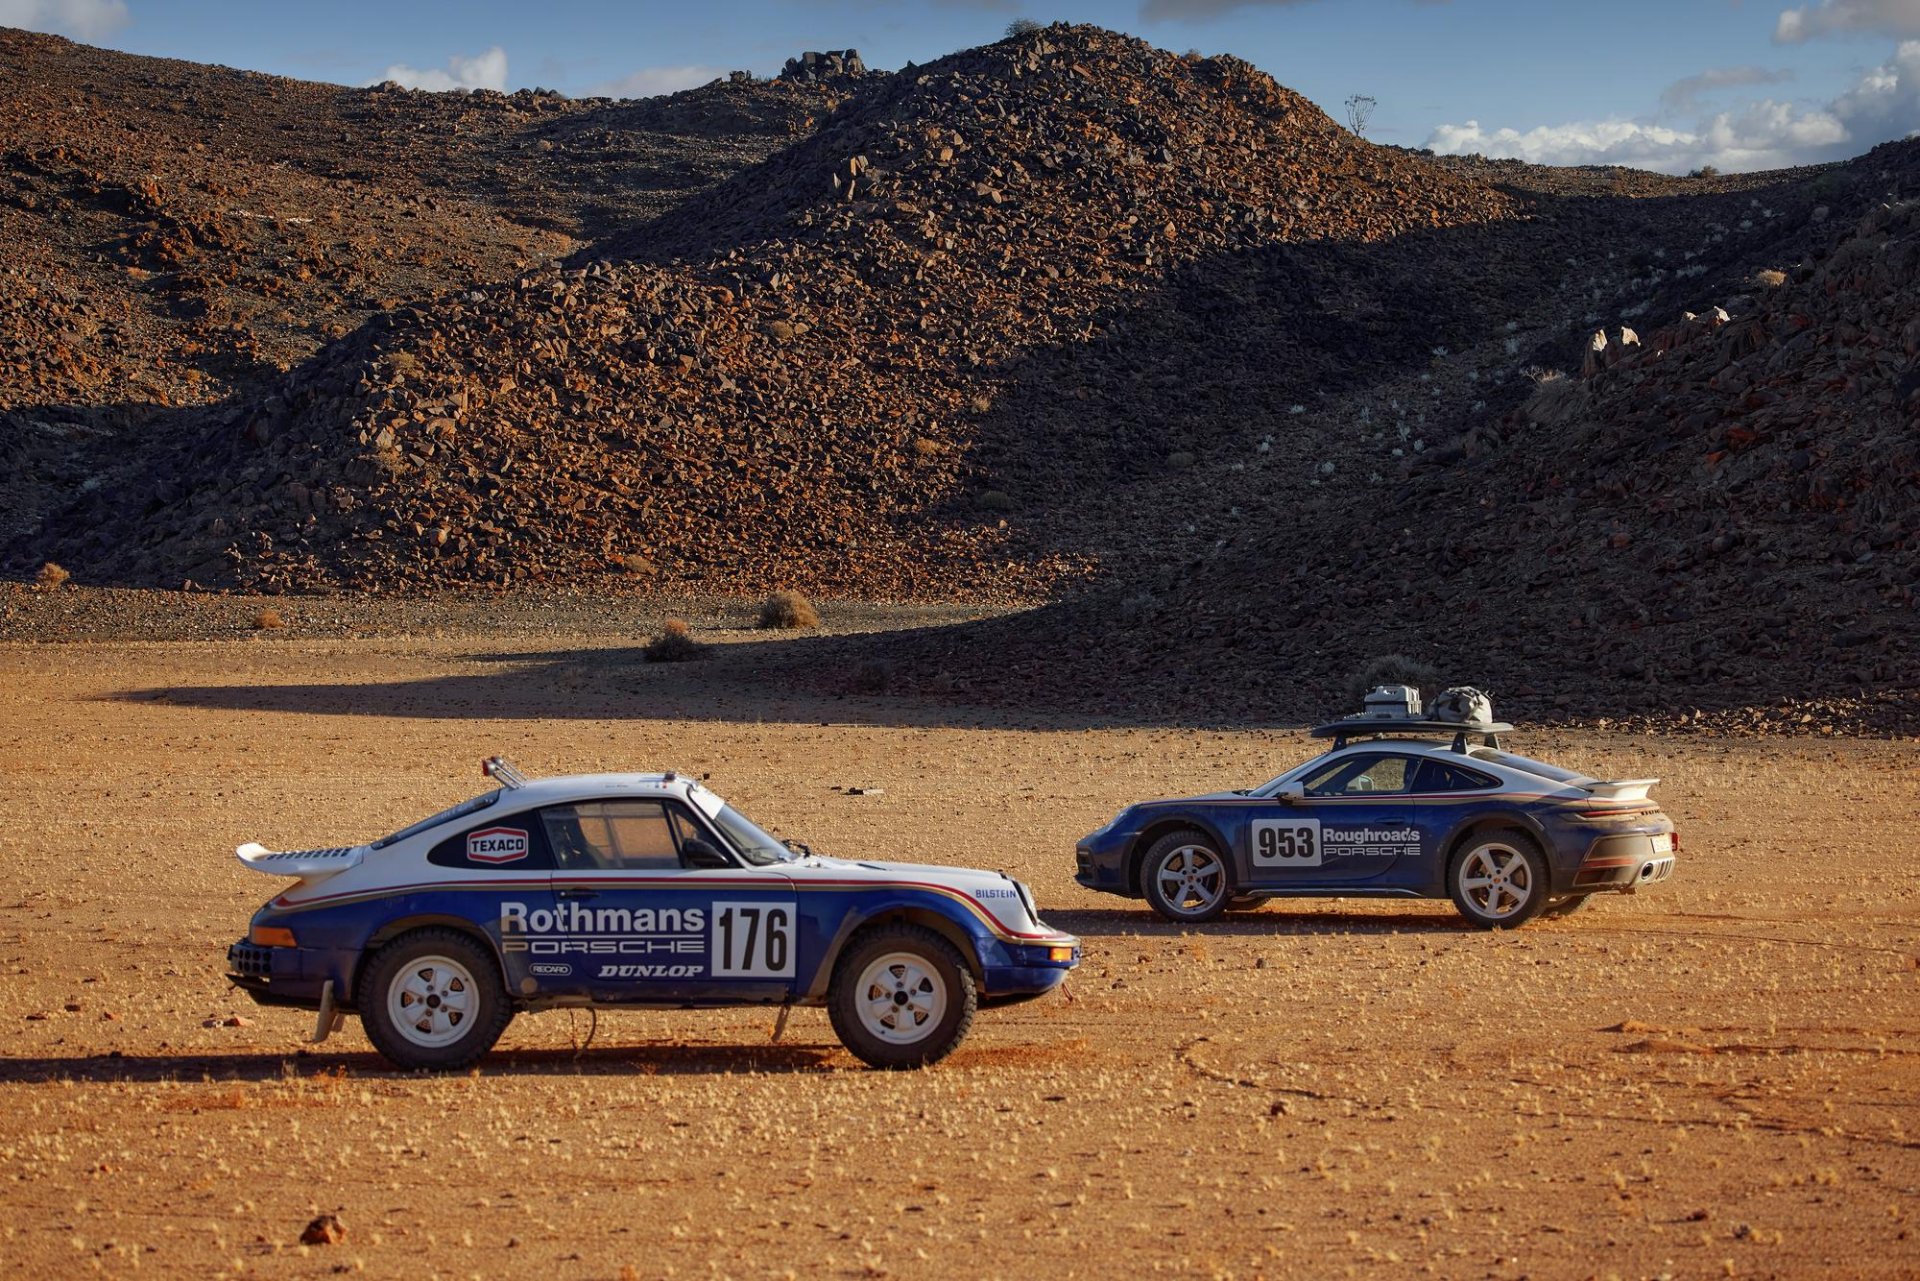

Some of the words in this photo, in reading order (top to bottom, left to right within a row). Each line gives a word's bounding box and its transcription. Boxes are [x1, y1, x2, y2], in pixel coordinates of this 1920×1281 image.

[1259, 827, 1315, 858] 953
[1323, 828, 1421, 844] Roughroads
[471, 838, 524, 852] TEXACO
[1323, 847, 1421, 856] PORSCHE
[975, 889, 1016, 899] BILSTEIN
[501, 902, 705, 932] Rothmans
[718, 907, 788, 971] 176
[502, 941, 705, 954] PORSCHE
[532, 965, 569, 974] RECARO
[598, 965, 704, 977] DUNLOP
